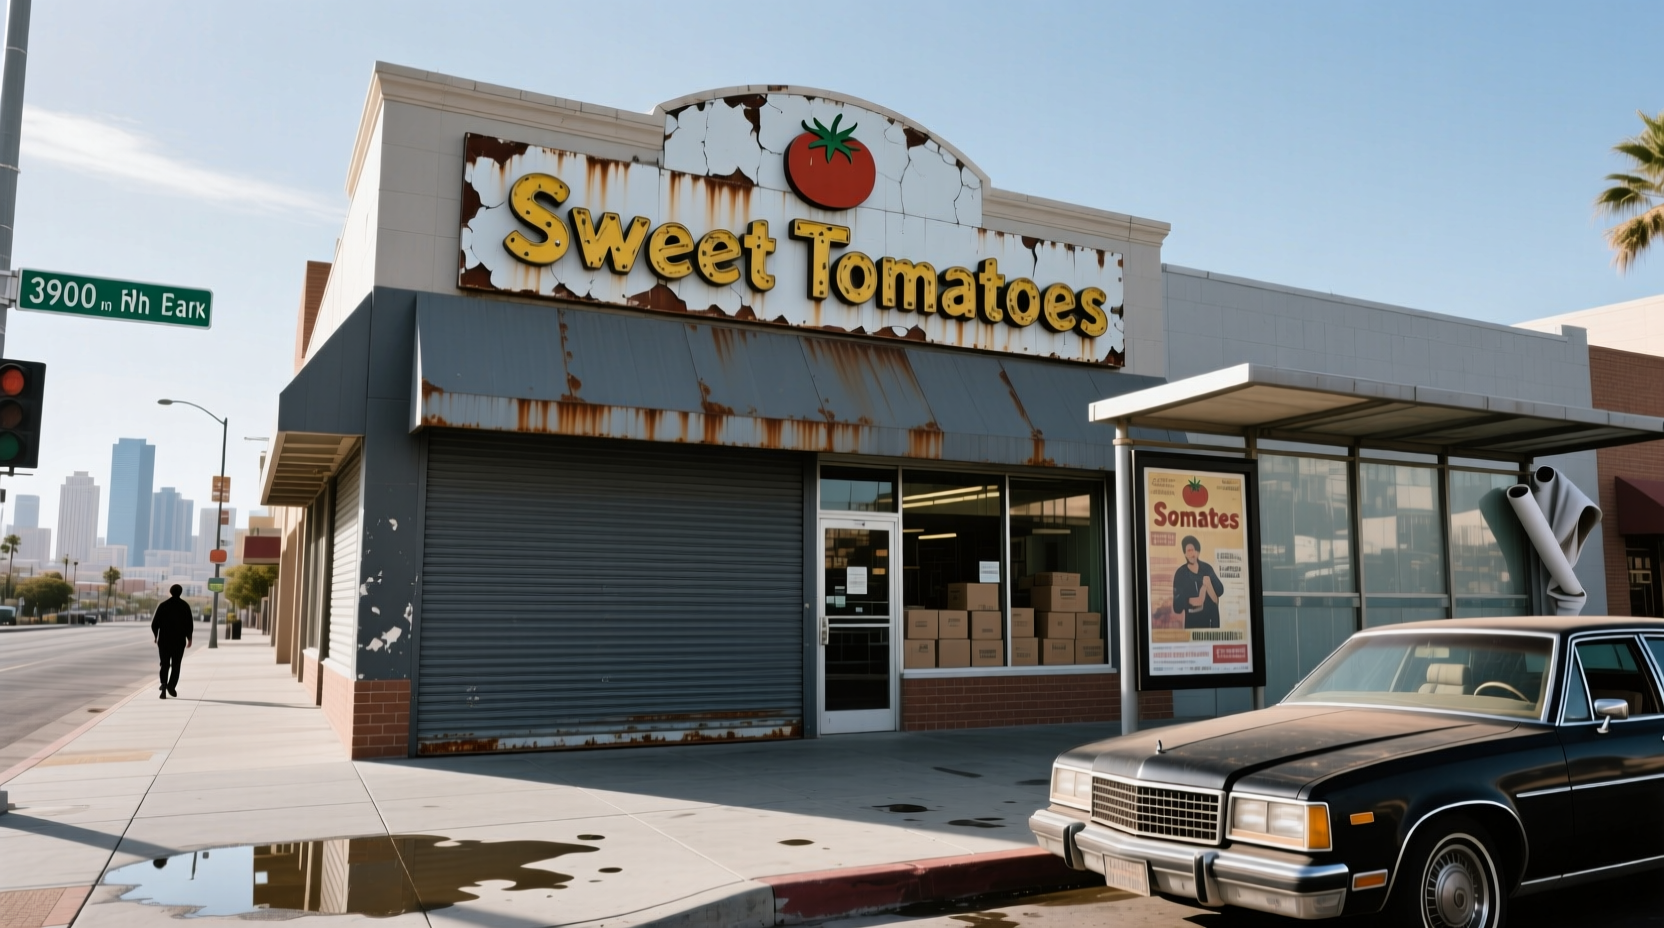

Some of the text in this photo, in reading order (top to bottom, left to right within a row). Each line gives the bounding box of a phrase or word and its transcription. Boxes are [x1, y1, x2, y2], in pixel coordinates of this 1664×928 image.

[503, 172, 1108, 338] Sweet Tomatoes
[29, 277, 97, 309] 3900
[1153, 501, 1239, 530] Somates
